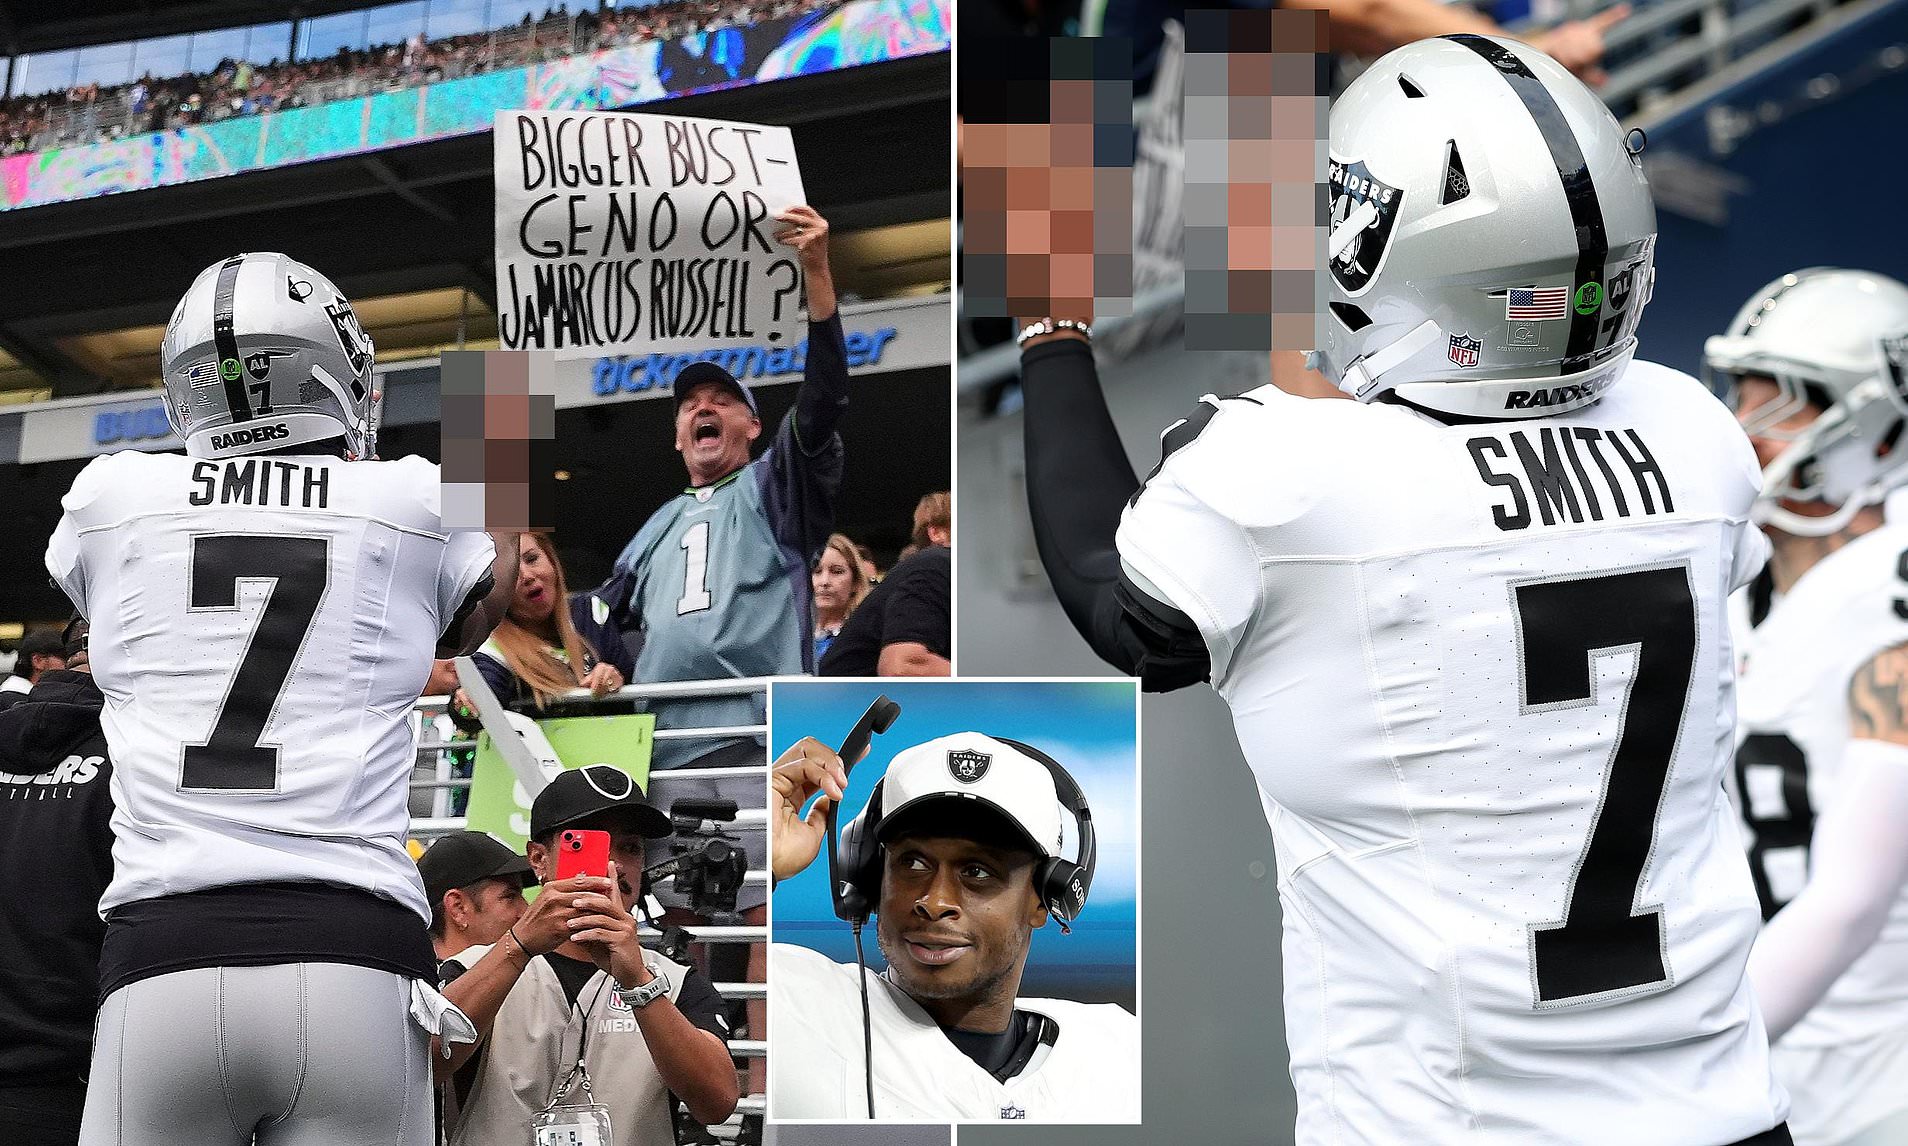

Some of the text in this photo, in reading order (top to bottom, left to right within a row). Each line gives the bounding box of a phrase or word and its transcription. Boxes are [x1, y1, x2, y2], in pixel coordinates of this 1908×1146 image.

[517, 115, 650, 191] BIGGER
[1329, 163, 1393, 204] RAIDERS
[518, 189, 774, 259] GENO OR
[1611, 276, 1630, 299] AL
[250, 358, 269, 371] AL
[593, 325, 897, 396] tickmaer
[1450, 346, 1476, 365] NFL
[211, 423, 290, 451] RAIDERS
[189, 460, 329, 508] SMITH
[1466, 427, 1675, 532] SMITH
[677, 521, 711, 617] 1
[176, 531, 334, 795] 7
[1506, 557, 1700, 1010] 7
[598, 1018, 641, 1033] MED
